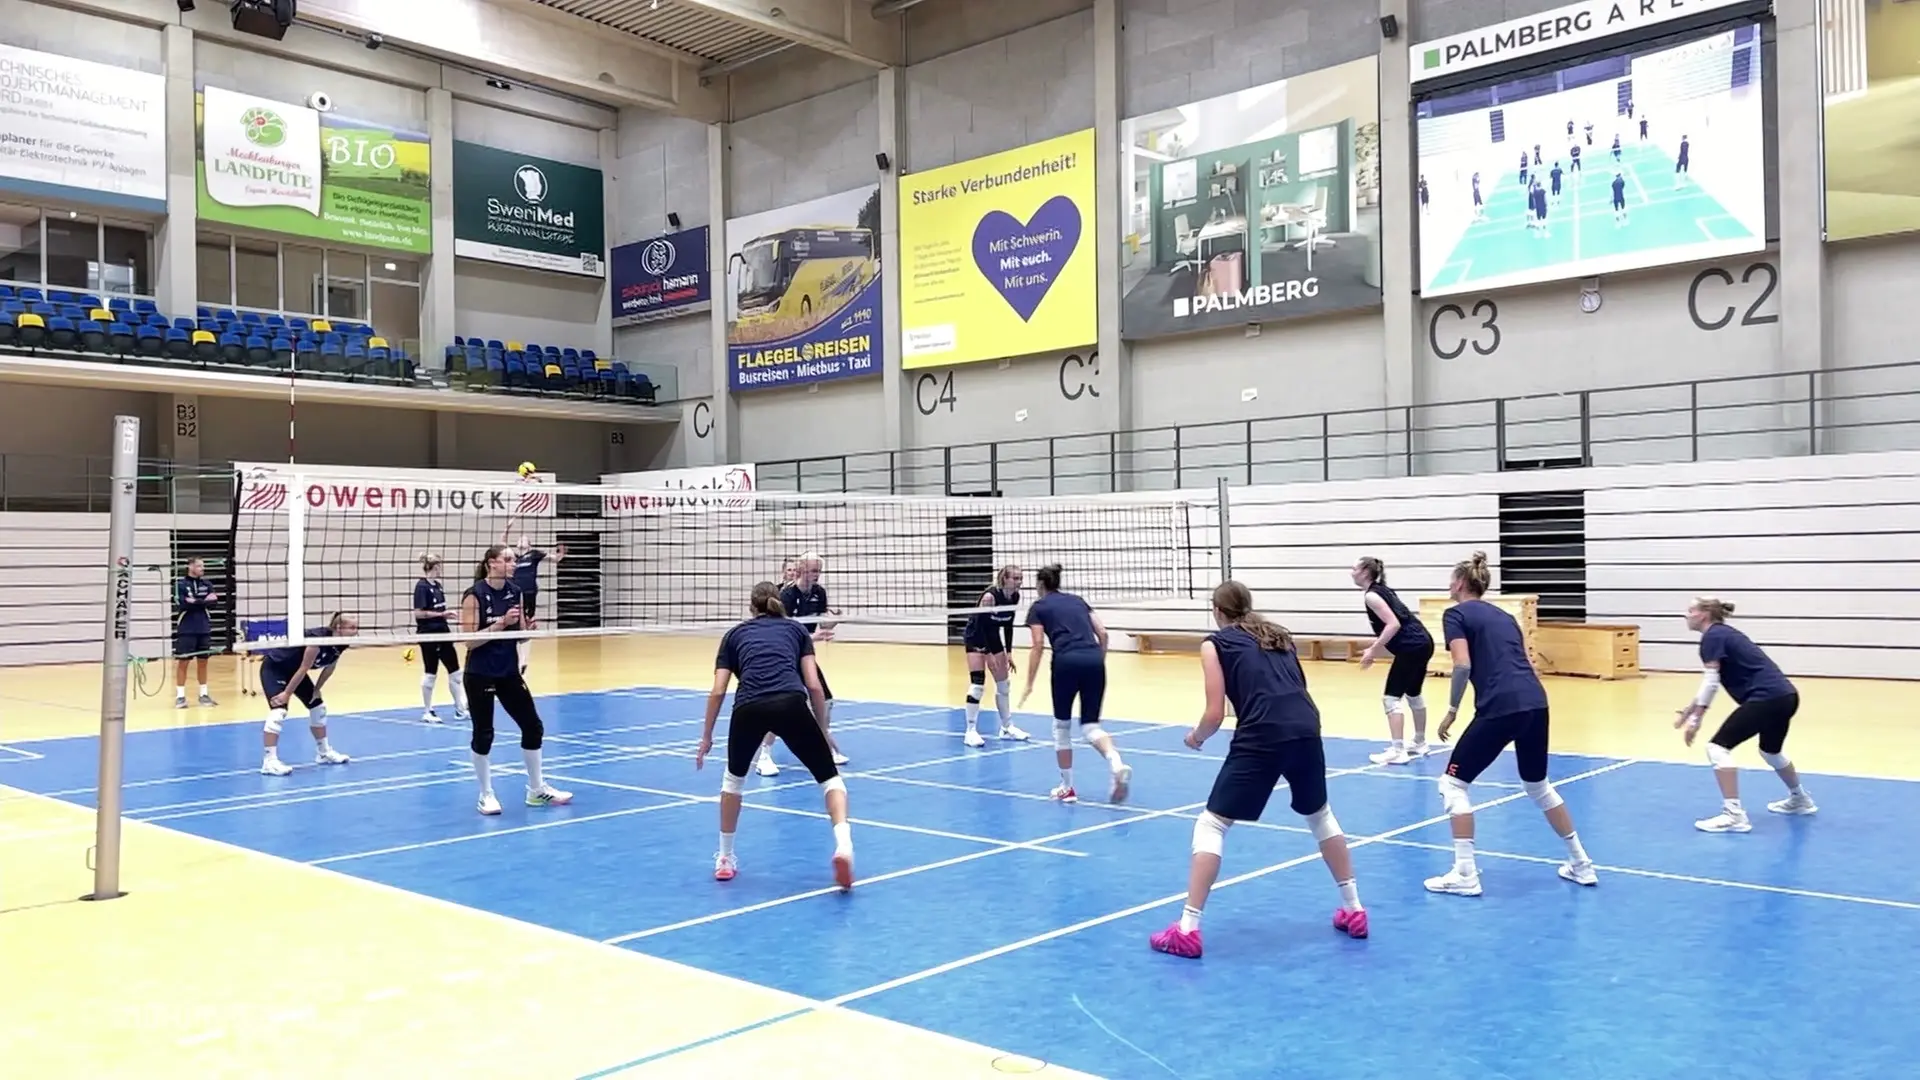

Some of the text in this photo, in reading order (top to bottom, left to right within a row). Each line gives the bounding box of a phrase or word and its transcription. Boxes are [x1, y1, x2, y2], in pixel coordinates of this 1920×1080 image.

[1445, 11, 1592, 64] PALMBERG
[0, 74, 148, 113] OJEKTMANAGEMENT
[0, 131, 37, 146] planer
[327, 135, 396, 170] BIO
[214, 158, 313, 190] LANDPUTE
[912, 151, 1078, 207] Starke Verbundenheit!
[487, 196, 575, 228] SweriMed
[989, 227, 1064, 255] Mit Schwerin.
[1000, 249, 1053, 271] Mit euch.
[1004, 272, 1049, 291] Mit uns.
[1192, 276, 1320, 316] PALMBERG
[1688, 262, 1779, 331] C2
[1429, 300, 1501, 360] C3
[737, 334, 871, 369] FLAEGEL REISEN
[738, 353, 872, 385] Busreisen Mietbus Taxi
[916, 369, 957, 416] C4
[177, 404, 197, 420] B3
[693, 401, 715, 438] C
[177, 421, 198, 438] B2
[306, 483, 506, 510] owenblock
